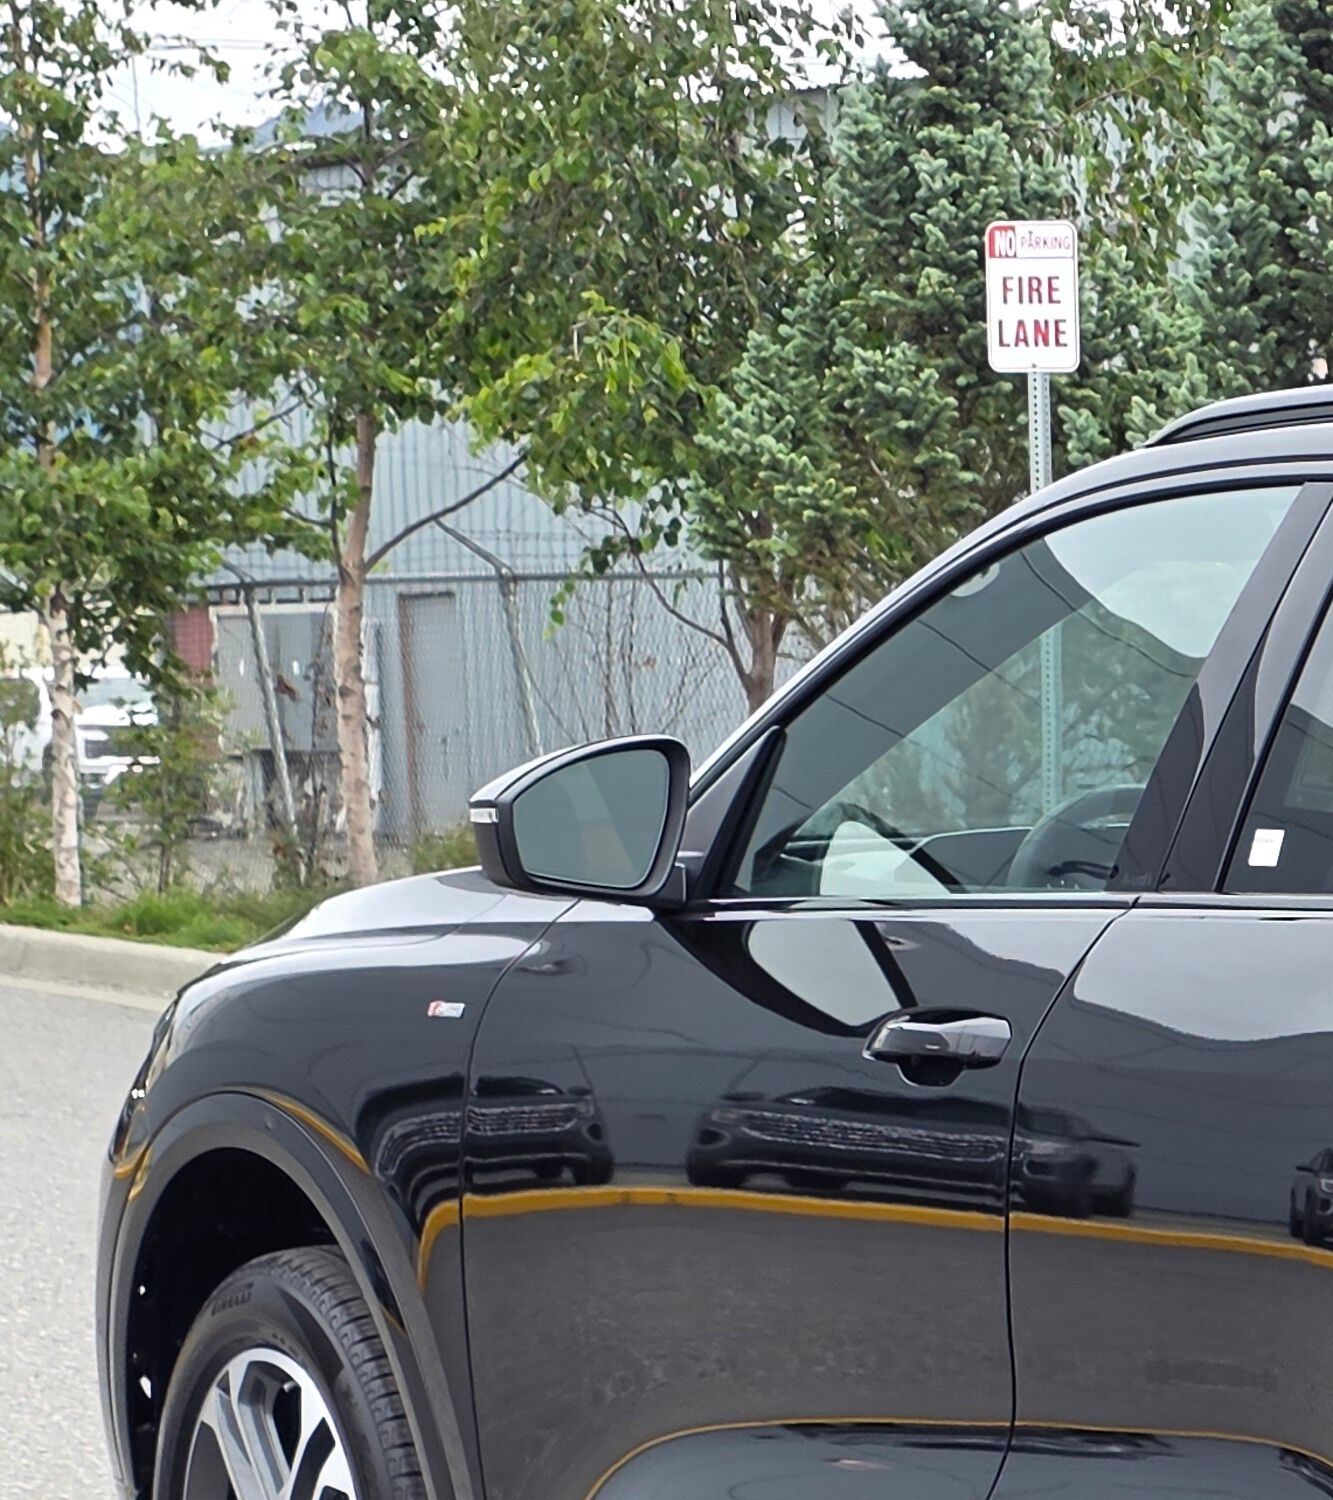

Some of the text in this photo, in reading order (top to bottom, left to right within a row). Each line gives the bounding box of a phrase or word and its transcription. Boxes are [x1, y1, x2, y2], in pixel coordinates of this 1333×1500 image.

[994, 229, 1071, 257] NO PARKING
[1002, 275, 1062, 305] FIRE
[998, 318, 1068, 348] LANE
